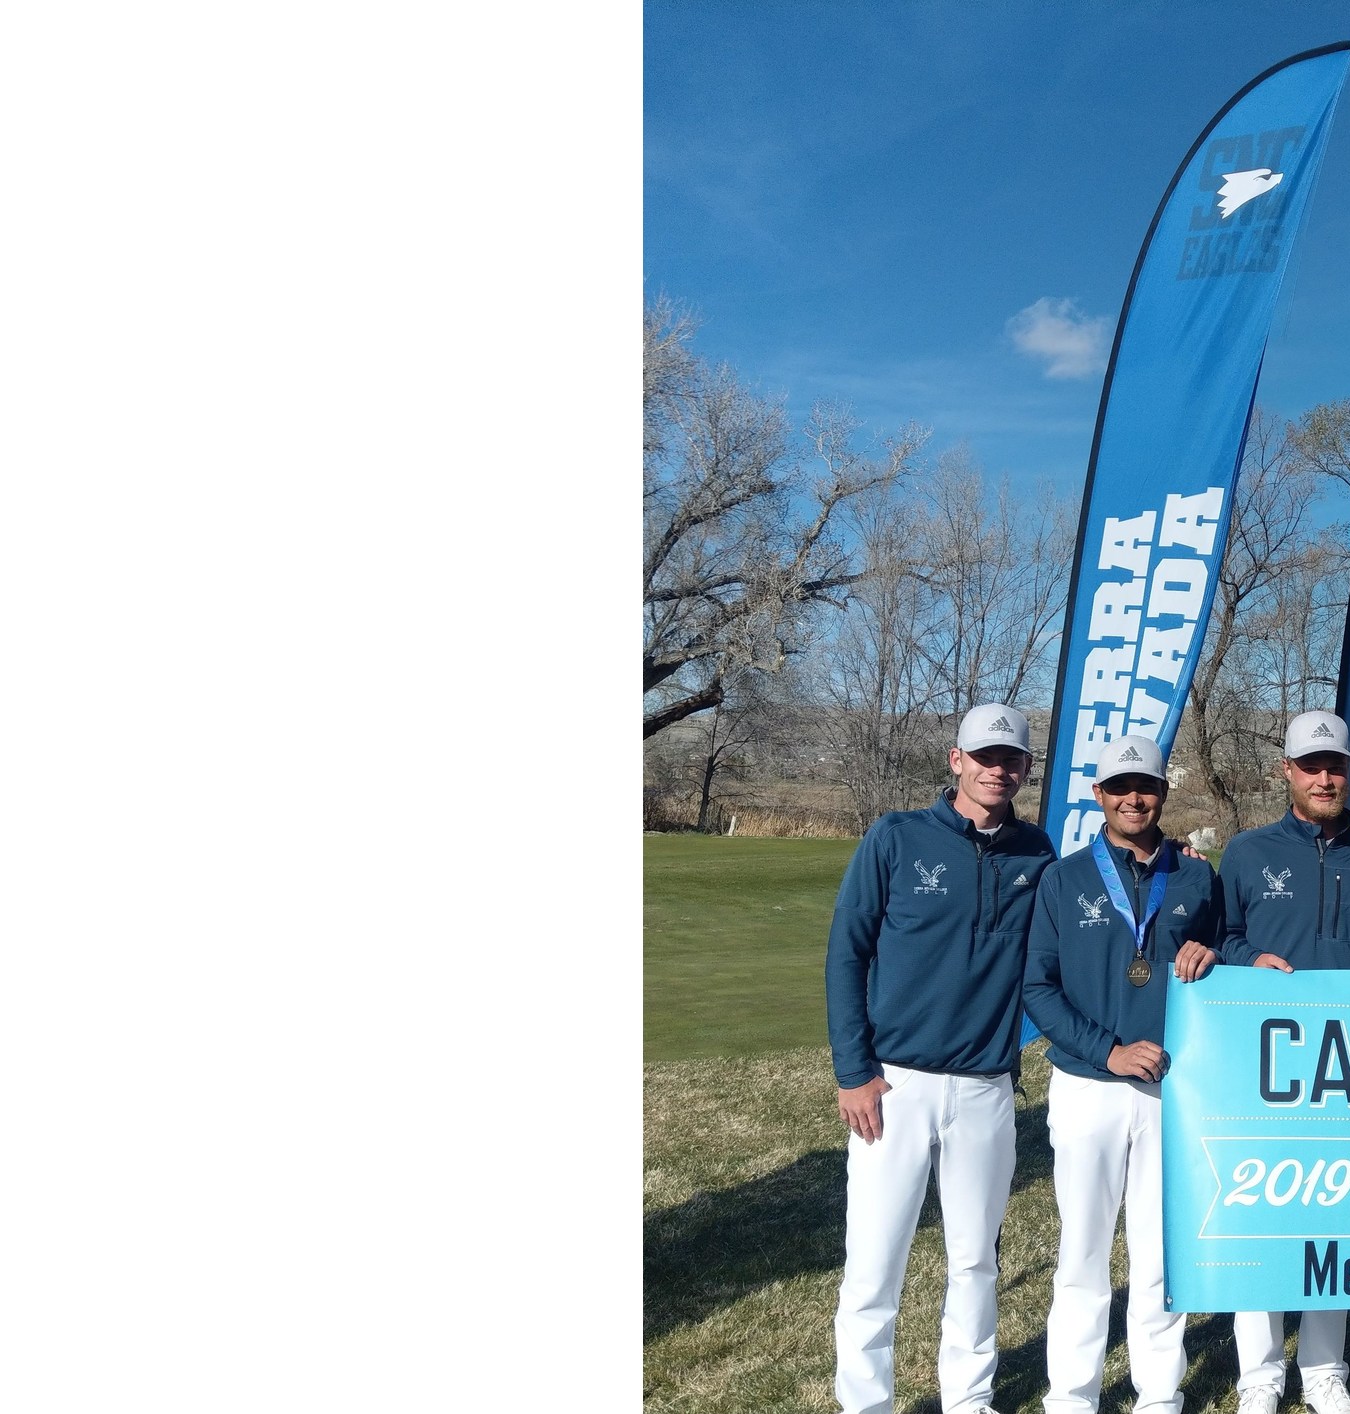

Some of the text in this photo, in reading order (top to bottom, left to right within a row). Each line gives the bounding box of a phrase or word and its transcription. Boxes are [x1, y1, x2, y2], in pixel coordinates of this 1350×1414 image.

[1127, 487, 1225, 741] VADA
[988, 725, 1014, 734] adidas
[1118, 753, 1143, 762] adidas
